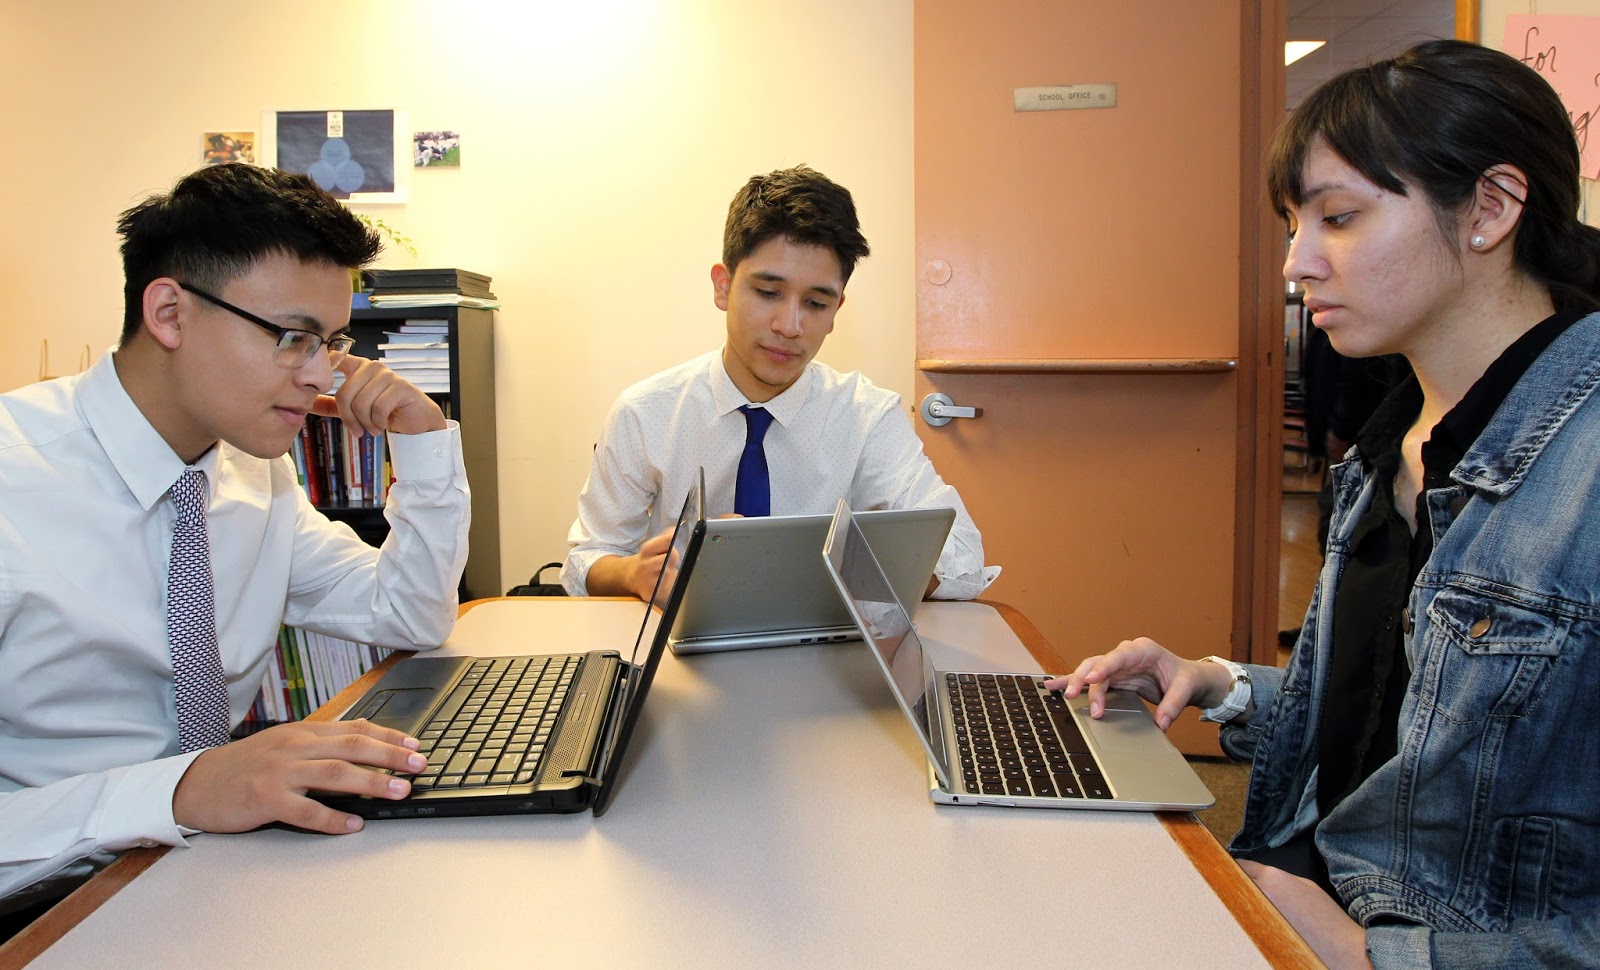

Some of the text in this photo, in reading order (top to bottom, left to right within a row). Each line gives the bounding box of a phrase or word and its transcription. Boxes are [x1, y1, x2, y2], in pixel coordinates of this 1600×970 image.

[1520, 26, 1557, 72] for
[1038, 92, 1091, 101] SCHOOL OFFICE
